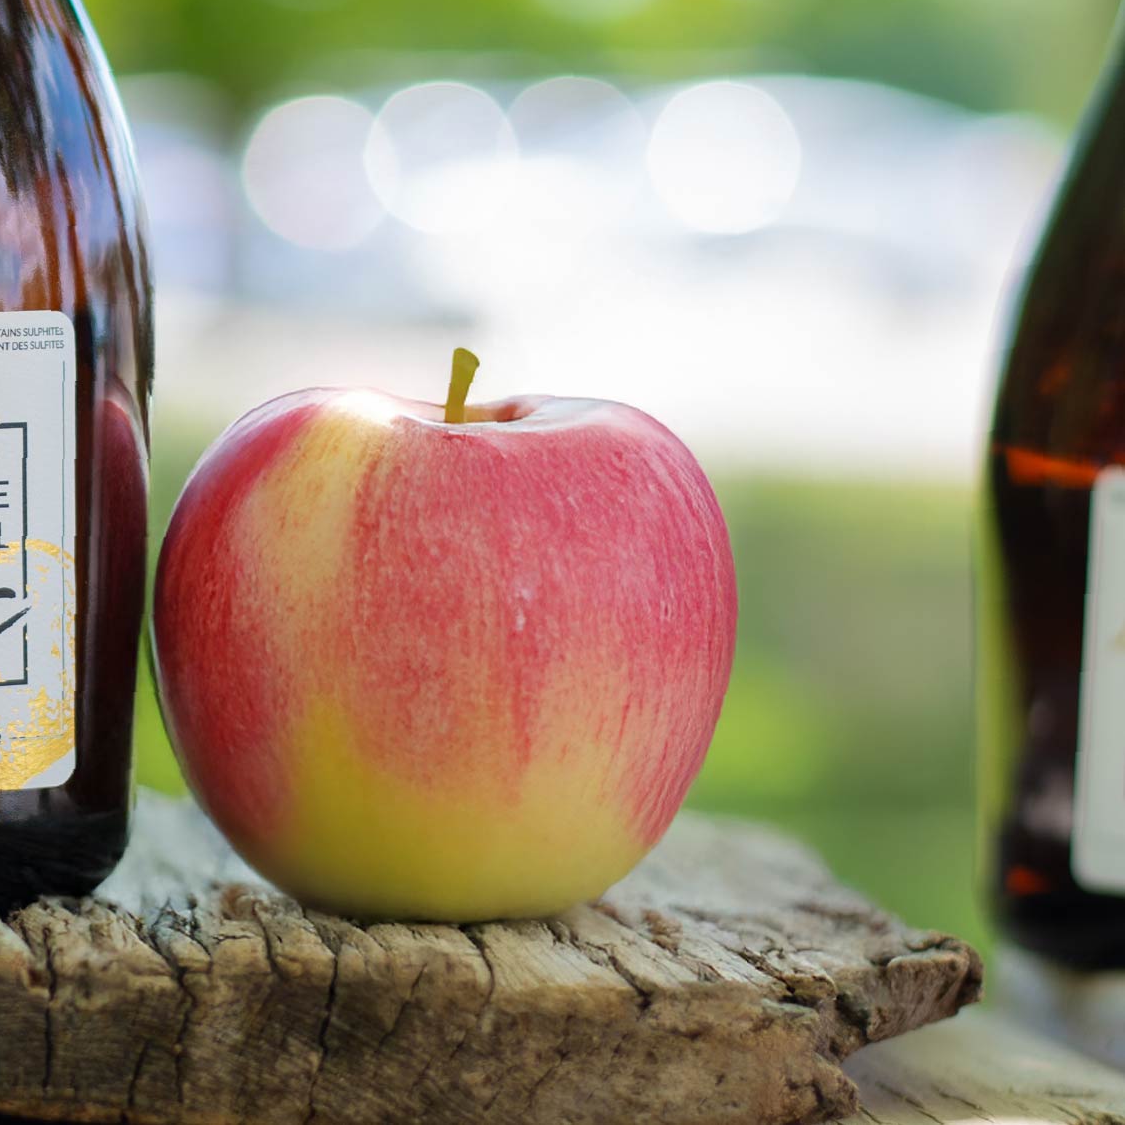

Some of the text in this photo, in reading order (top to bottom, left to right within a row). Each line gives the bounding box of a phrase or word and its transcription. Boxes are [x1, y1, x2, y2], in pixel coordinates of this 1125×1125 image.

[22, 326, 64, 337] SULPHITES
[11, 340, 29, 351] DES
[29, 339, 65, 350] SULFITES
